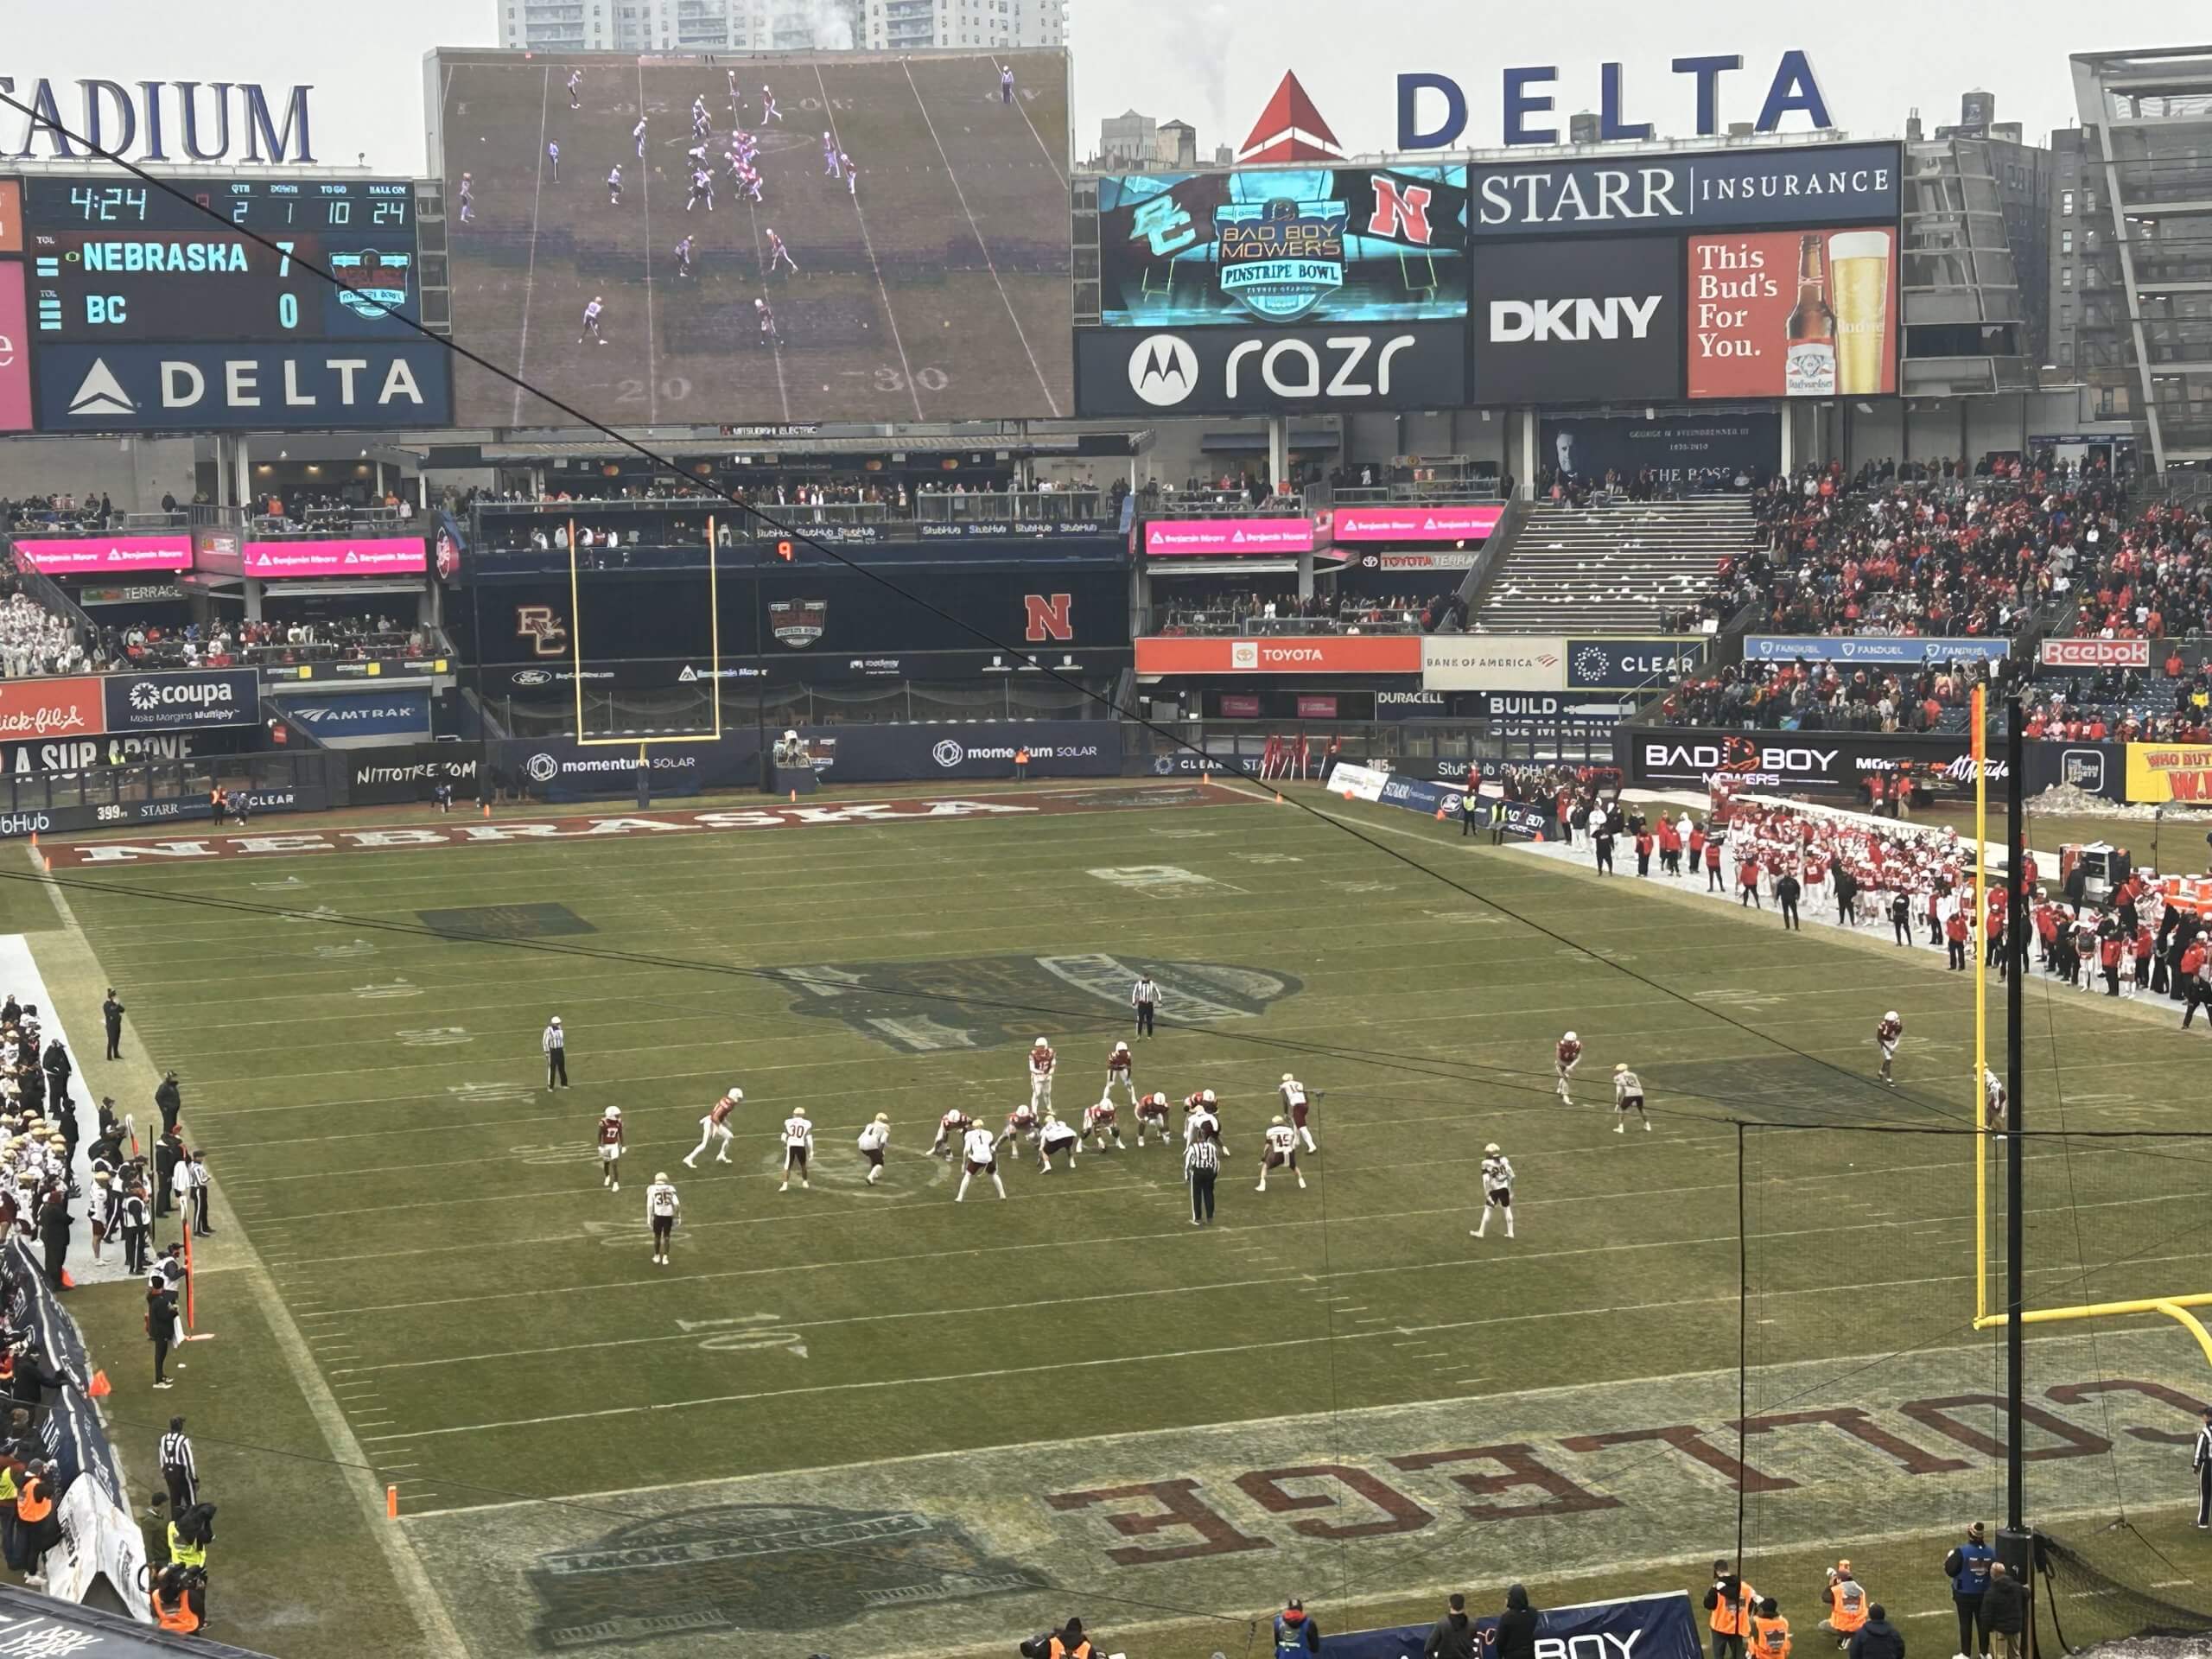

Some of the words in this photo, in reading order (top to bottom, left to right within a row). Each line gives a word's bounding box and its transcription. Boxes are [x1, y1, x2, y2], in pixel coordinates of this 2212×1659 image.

[1397, 49, 1836, 149] DELTA
[0, 76, 315, 165] ADIUM
[71, 188, 147, 220] 4:24
[1479, 167, 1683, 225] STARR
[1700, 168, 1890, 200] INSURANCE
[233, 200, 248, 223] 2
[287, 202, 294, 225] 1
[328, 201, 350, 225] 10
[373, 202, 404, 226] 24
[1368, 175, 1433, 245] N
[1224, 226, 1275, 242] BAD
[1285, 224, 1338, 240] BOY
[83, 242, 249, 272] NEBRASKA
[276, 241, 295, 277] 7
[1222, 240, 1340, 258] MOWERS
[1697, 245, 1764, 270] This
[1225, 264, 1292, 284] PINSTRIPE
[1299, 264, 1339, 281] BOWL
[1697, 272, 1778, 299] Bud's
[86, 295, 127, 324] BC
[279, 293, 298, 328] 0
[1490, 296, 1662, 342] DKNY
[1697, 303, 1749, 328] For
[1697, 333, 1761, 358] You.
[1226, 335, 1415, 398] razr
[161, 359, 423, 407] DELTA
[778, 541, 791, 561] 9
[1433, 555, 1477, 564] TERRA
[1024, 594, 1073, 641] N
[1262, 649, 1323, 662] TOYOTA
[1427, 658, 1459, 668] BANK
[1462, 658, 1476, 668] OF
[1478, 658, 1533, 668] AMERICA
[1621, 656, 1694, 674] CLEAR
[2044, 643, 2146, 663] Reebok
[162, 683, 232, 707] coupa
[1378, 692, 1445, 705] DURACELL
[1490, 697, 1557, 715] BUILD
[0, 705, 85, 734] ick-fil-A
[327, 708, 411, 721] AMTRAK
[562, 758, 650, 773] momentum
[652, 757, 696, 769] SOLAR
[968, 746, 1053, 760] mometum
[1057, 746, 1097, 757] SOLAR
[1644, 744, 1719, 767] BAD
[1761, 750, 1839, 772] BOY
[2147, 753, 2180, 766] WHO
[2183, 752, 2212, 766] BUT
[1945, 753, 2010, 784] Atttude
[141, 804, 179, 817] STARR
[250, 793, 295, 807] CLEAR
[73, 798, 1039, 862] NEBRASKA
[789, 1125, 804, 1139] 30
[654, 1192, 673, 1207] 35
[1044, 1380, 2212, 1567] COLLEGE
[1535, 1629, 1642, 1659] BOY
